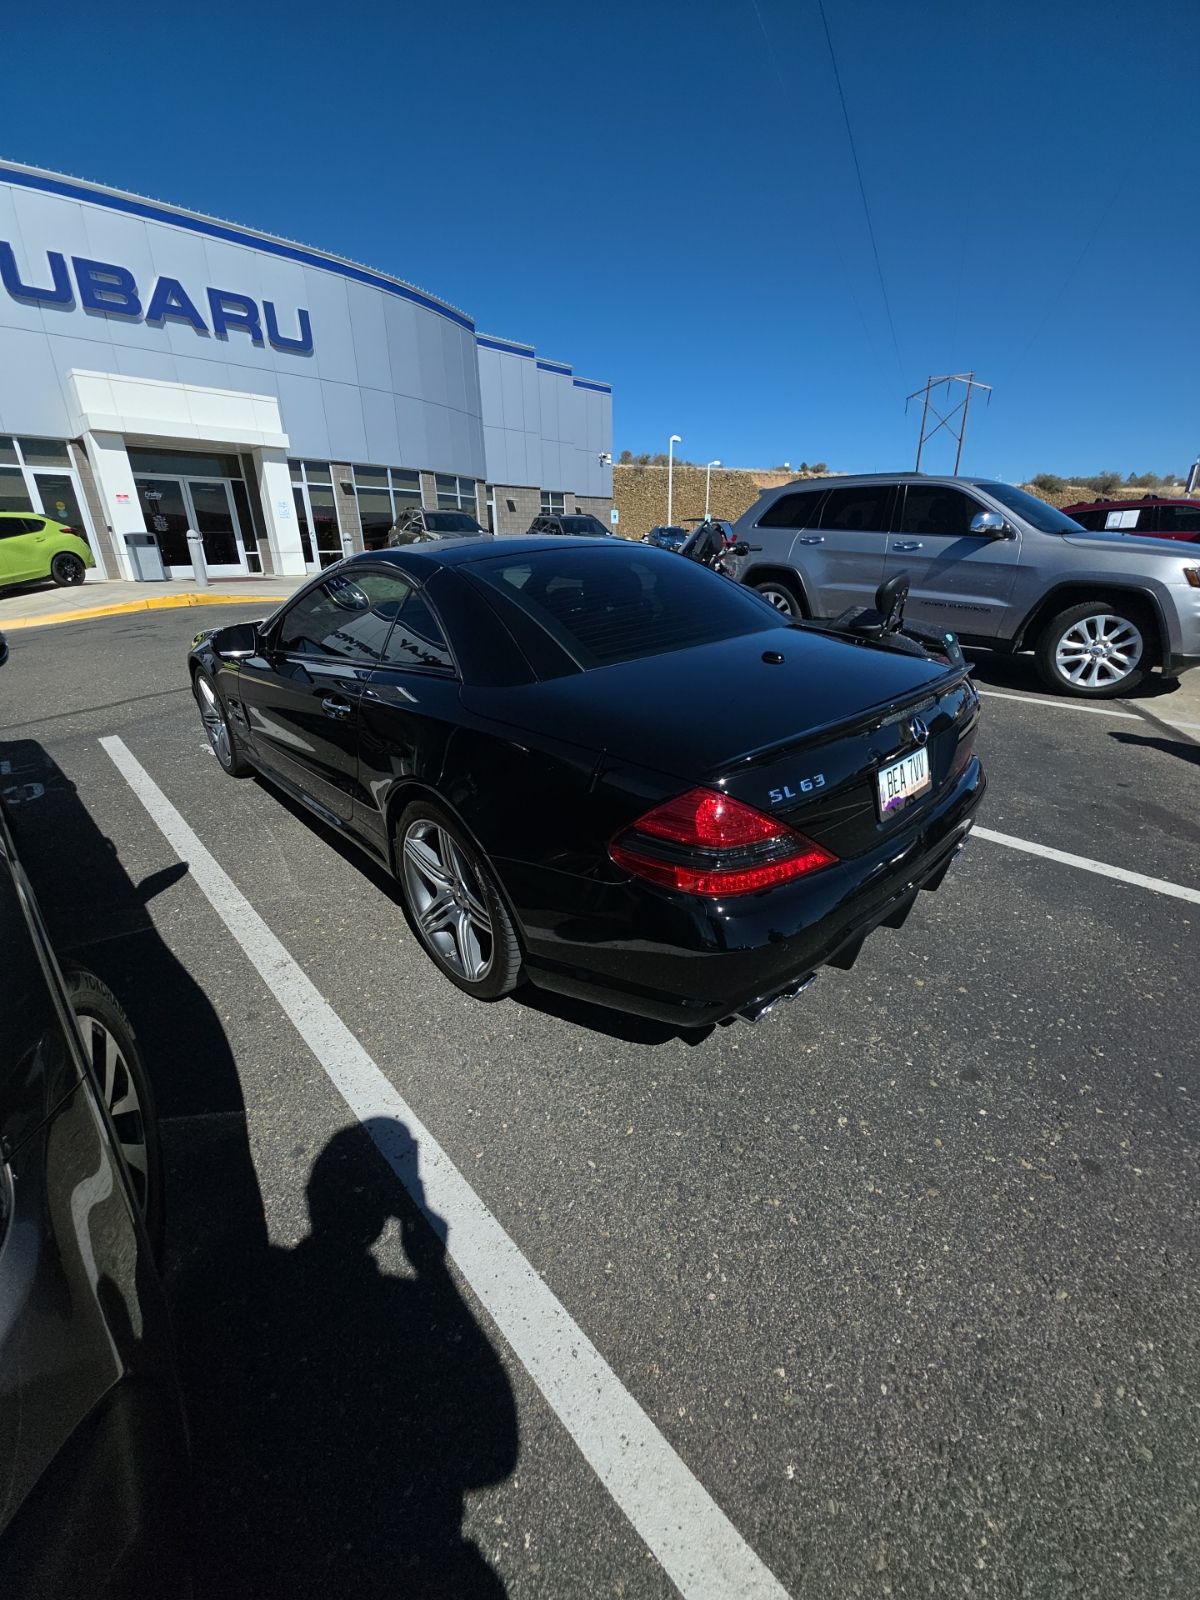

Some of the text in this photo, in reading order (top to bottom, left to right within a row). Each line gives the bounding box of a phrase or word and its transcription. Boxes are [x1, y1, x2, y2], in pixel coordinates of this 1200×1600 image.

[0, 240, 313, 356] UBARU
[768, 773, 826, 804] SL 63
[887, 764, 907, 798] BEA
